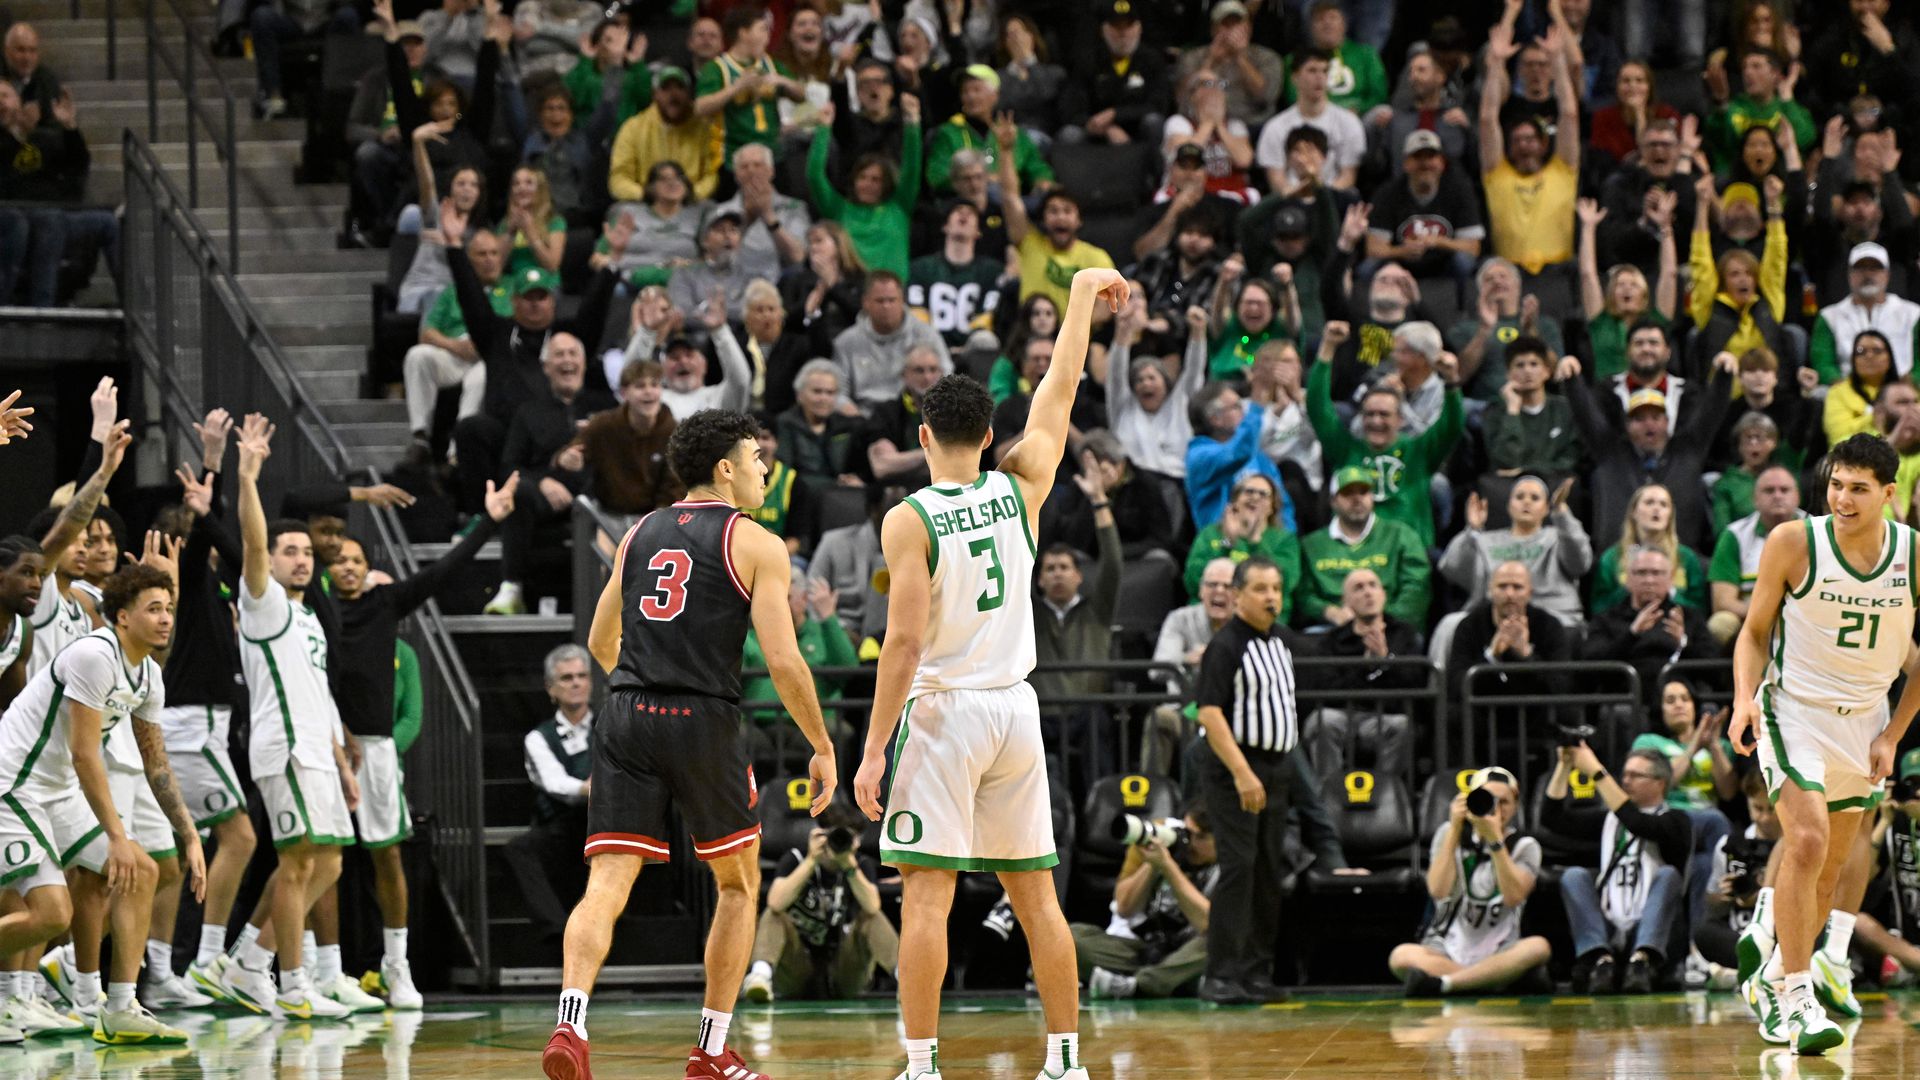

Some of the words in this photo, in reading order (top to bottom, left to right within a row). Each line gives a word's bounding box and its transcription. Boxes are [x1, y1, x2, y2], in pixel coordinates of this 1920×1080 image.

[932, 495, 1018, 537] SHELSAD
[639, 548, 693, 622] 3
[968, 536, 1005, 612] 3
[1820, 591, 1903, 608] DUCKS
[1837, 611, 1880, 649] 21
[204, 791, 228, 812] O
[277, 810, 296, 834] O
[887, 810, 923, 845] O
[5, 840, 31, 866] O
